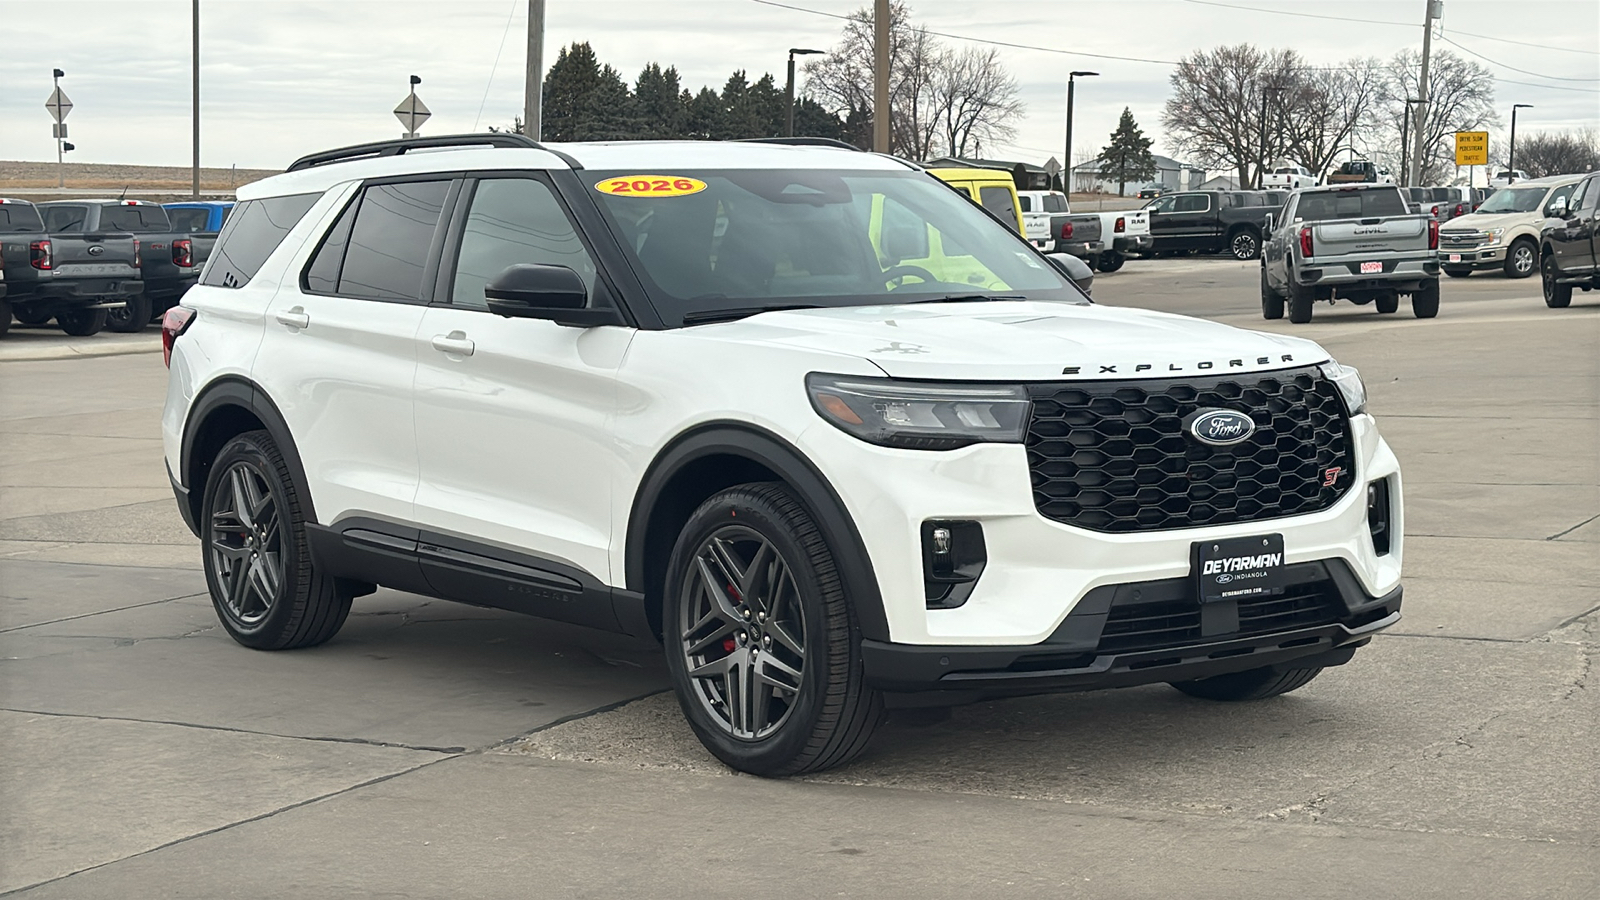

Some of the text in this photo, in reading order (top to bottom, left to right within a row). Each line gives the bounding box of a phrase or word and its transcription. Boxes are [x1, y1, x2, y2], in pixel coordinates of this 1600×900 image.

[610, 179, 694, 193] 2026
[1353, 226, 1388, 235] GMC
[1061, 353, 1295, 375] EXPLORER
[1208, 417, 1243, 438] Ford
[1322, 466, 1341, 487] ST
[1234, 571, 1268, 580] INDIANOLA
